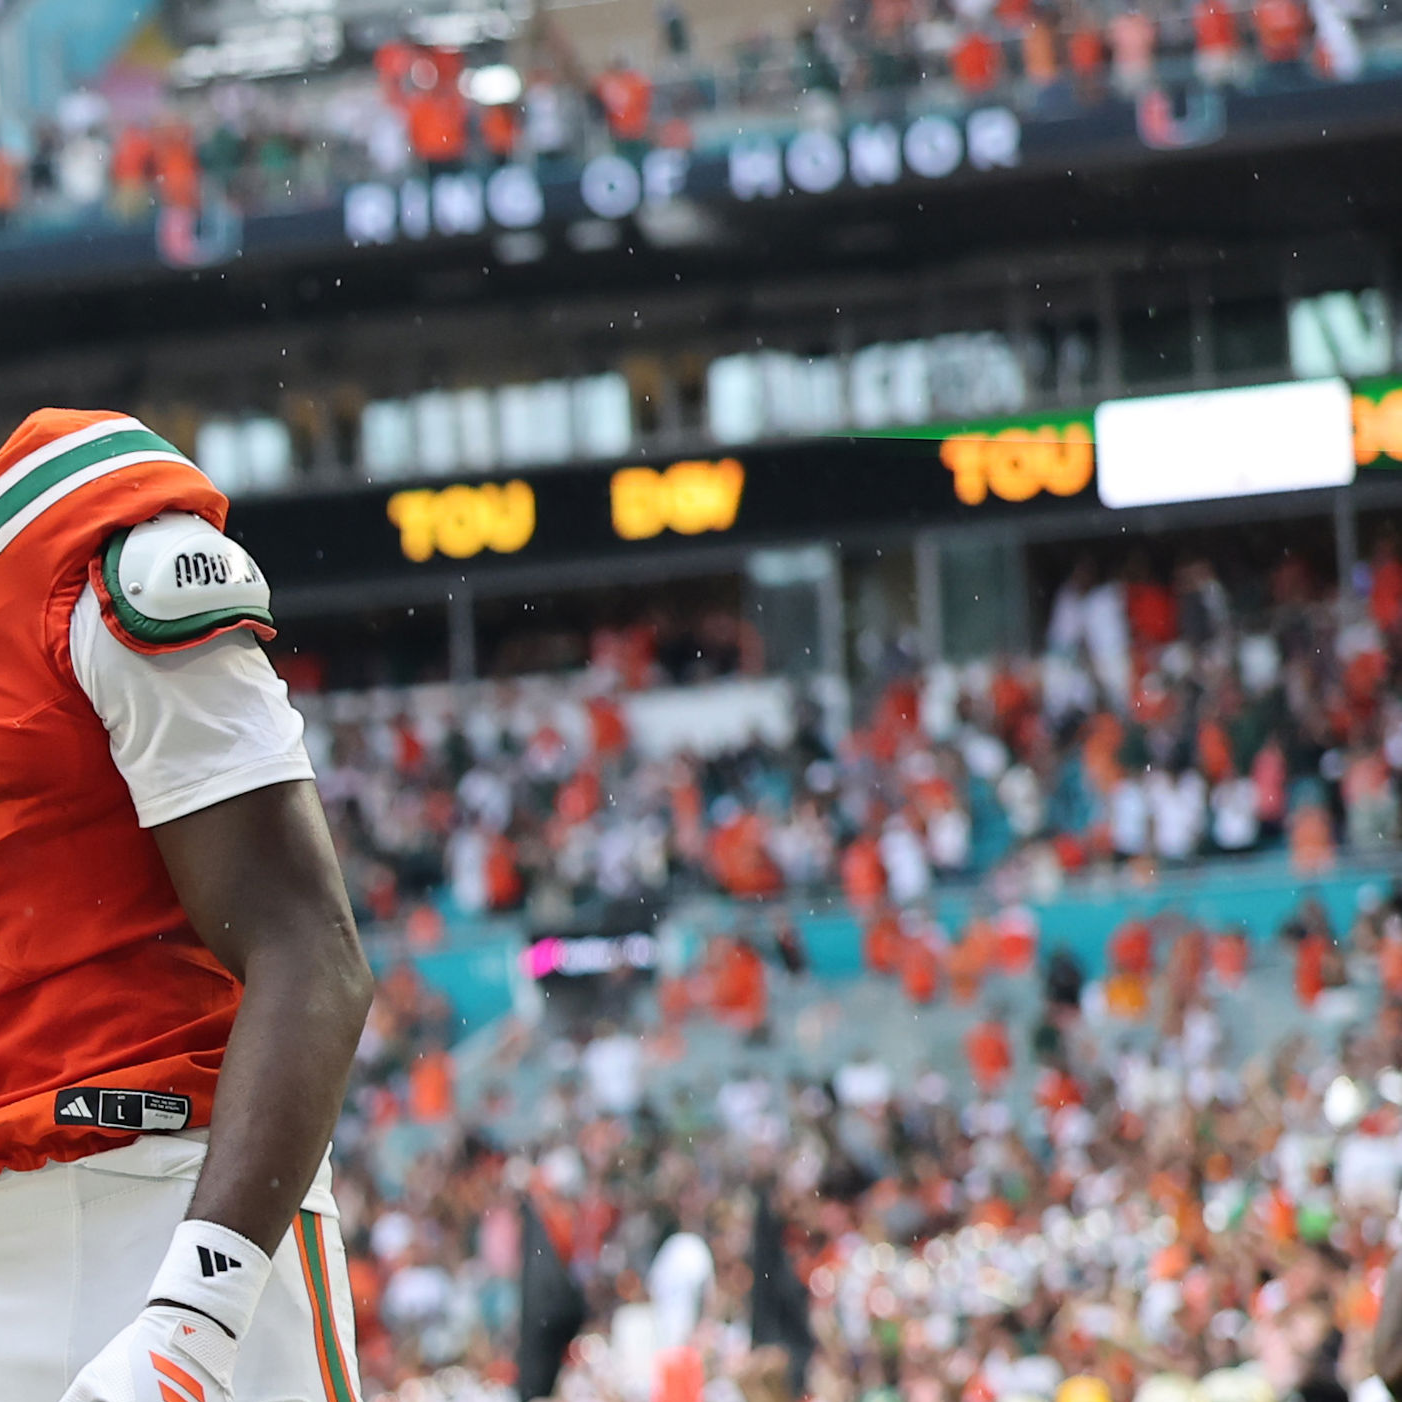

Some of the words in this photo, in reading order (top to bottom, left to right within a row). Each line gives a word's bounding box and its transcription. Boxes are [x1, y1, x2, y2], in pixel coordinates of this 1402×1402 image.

[345, 165, 544, 244] RING
[581, 148, 688, 219] OF
[729, 106, 1021, 200] HONOR
[117, 1105, 125, 1120] L
